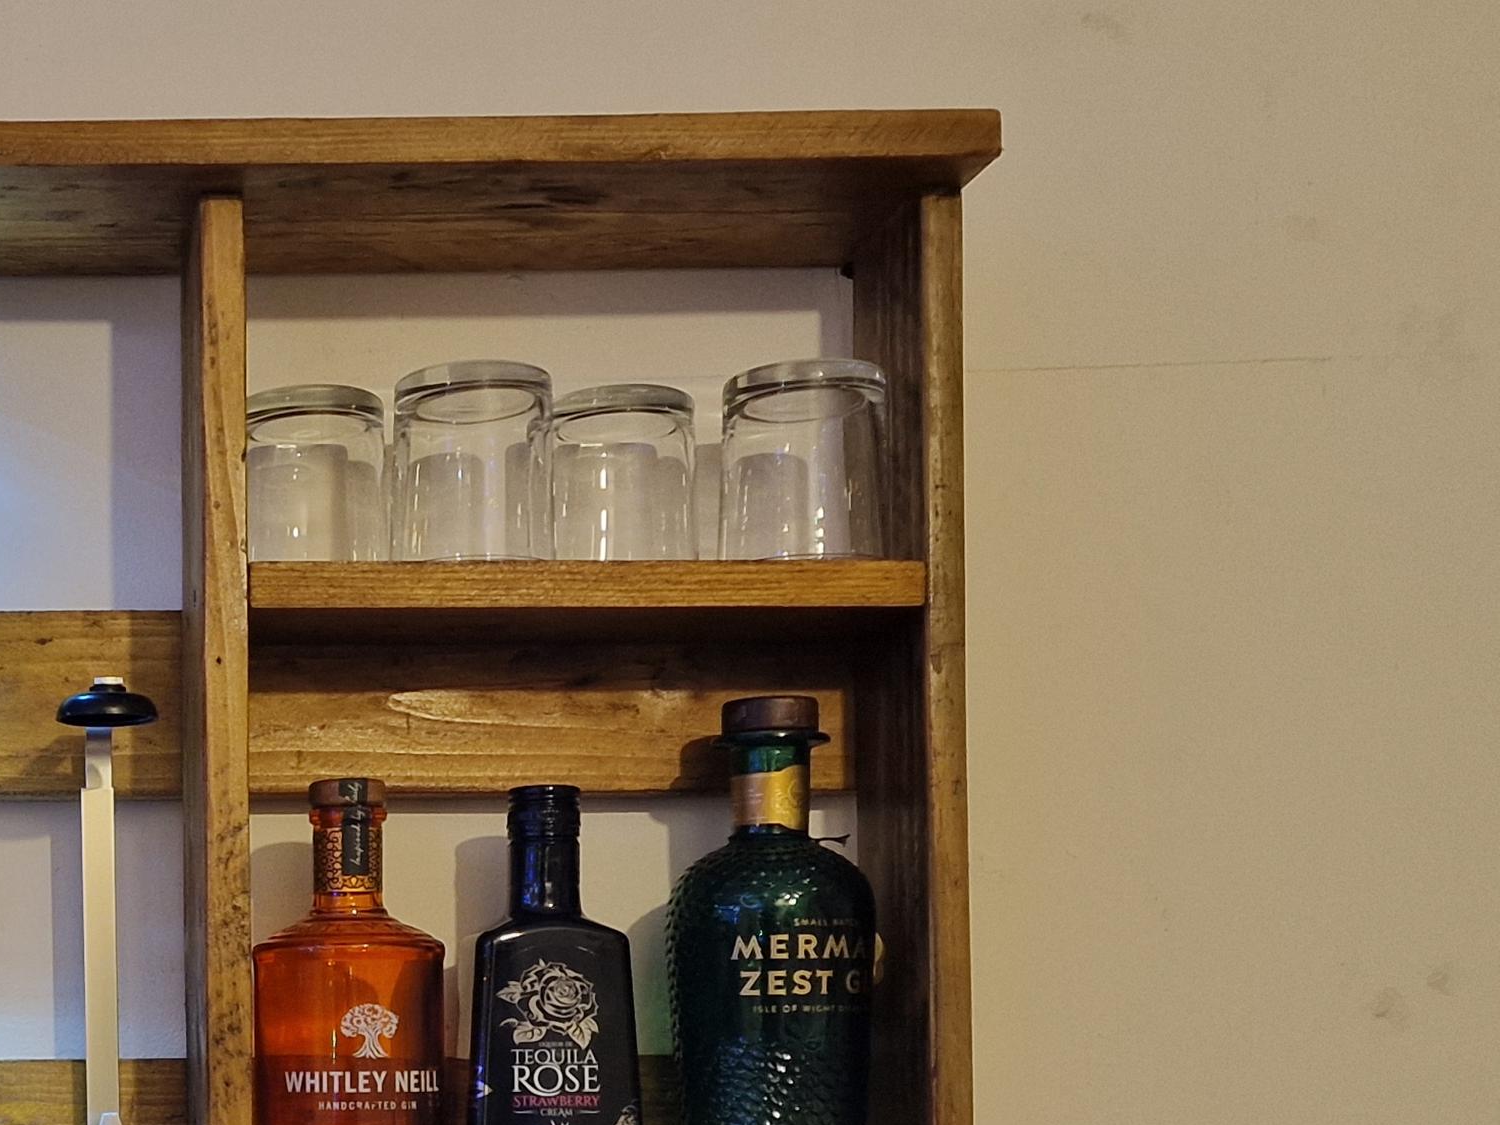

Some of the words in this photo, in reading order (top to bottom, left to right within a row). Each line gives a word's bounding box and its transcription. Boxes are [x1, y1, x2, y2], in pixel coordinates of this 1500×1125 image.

[793, 917, 829, 927] SMALL
[738, 969, 834, 996] ZEST
[752, 1004, 777, 1014] ISLE
[781, 1004, 798, 1014] OF
[510, 1048, 598, 1066] TEQUILA
[284, 1070, 388, 1094] WHITLEY
[394, 1069, 440, 1093] NEILL
[511, 1064, 601, 1097] ROSE
[318, 1101, 397, 1111] HANDCRAFTED
[401, 1101, 418, 1110] GIN
[513, 1095, 600, 1108] STRAWBERRY
[539, 1108, 574, 1118] CREAM
